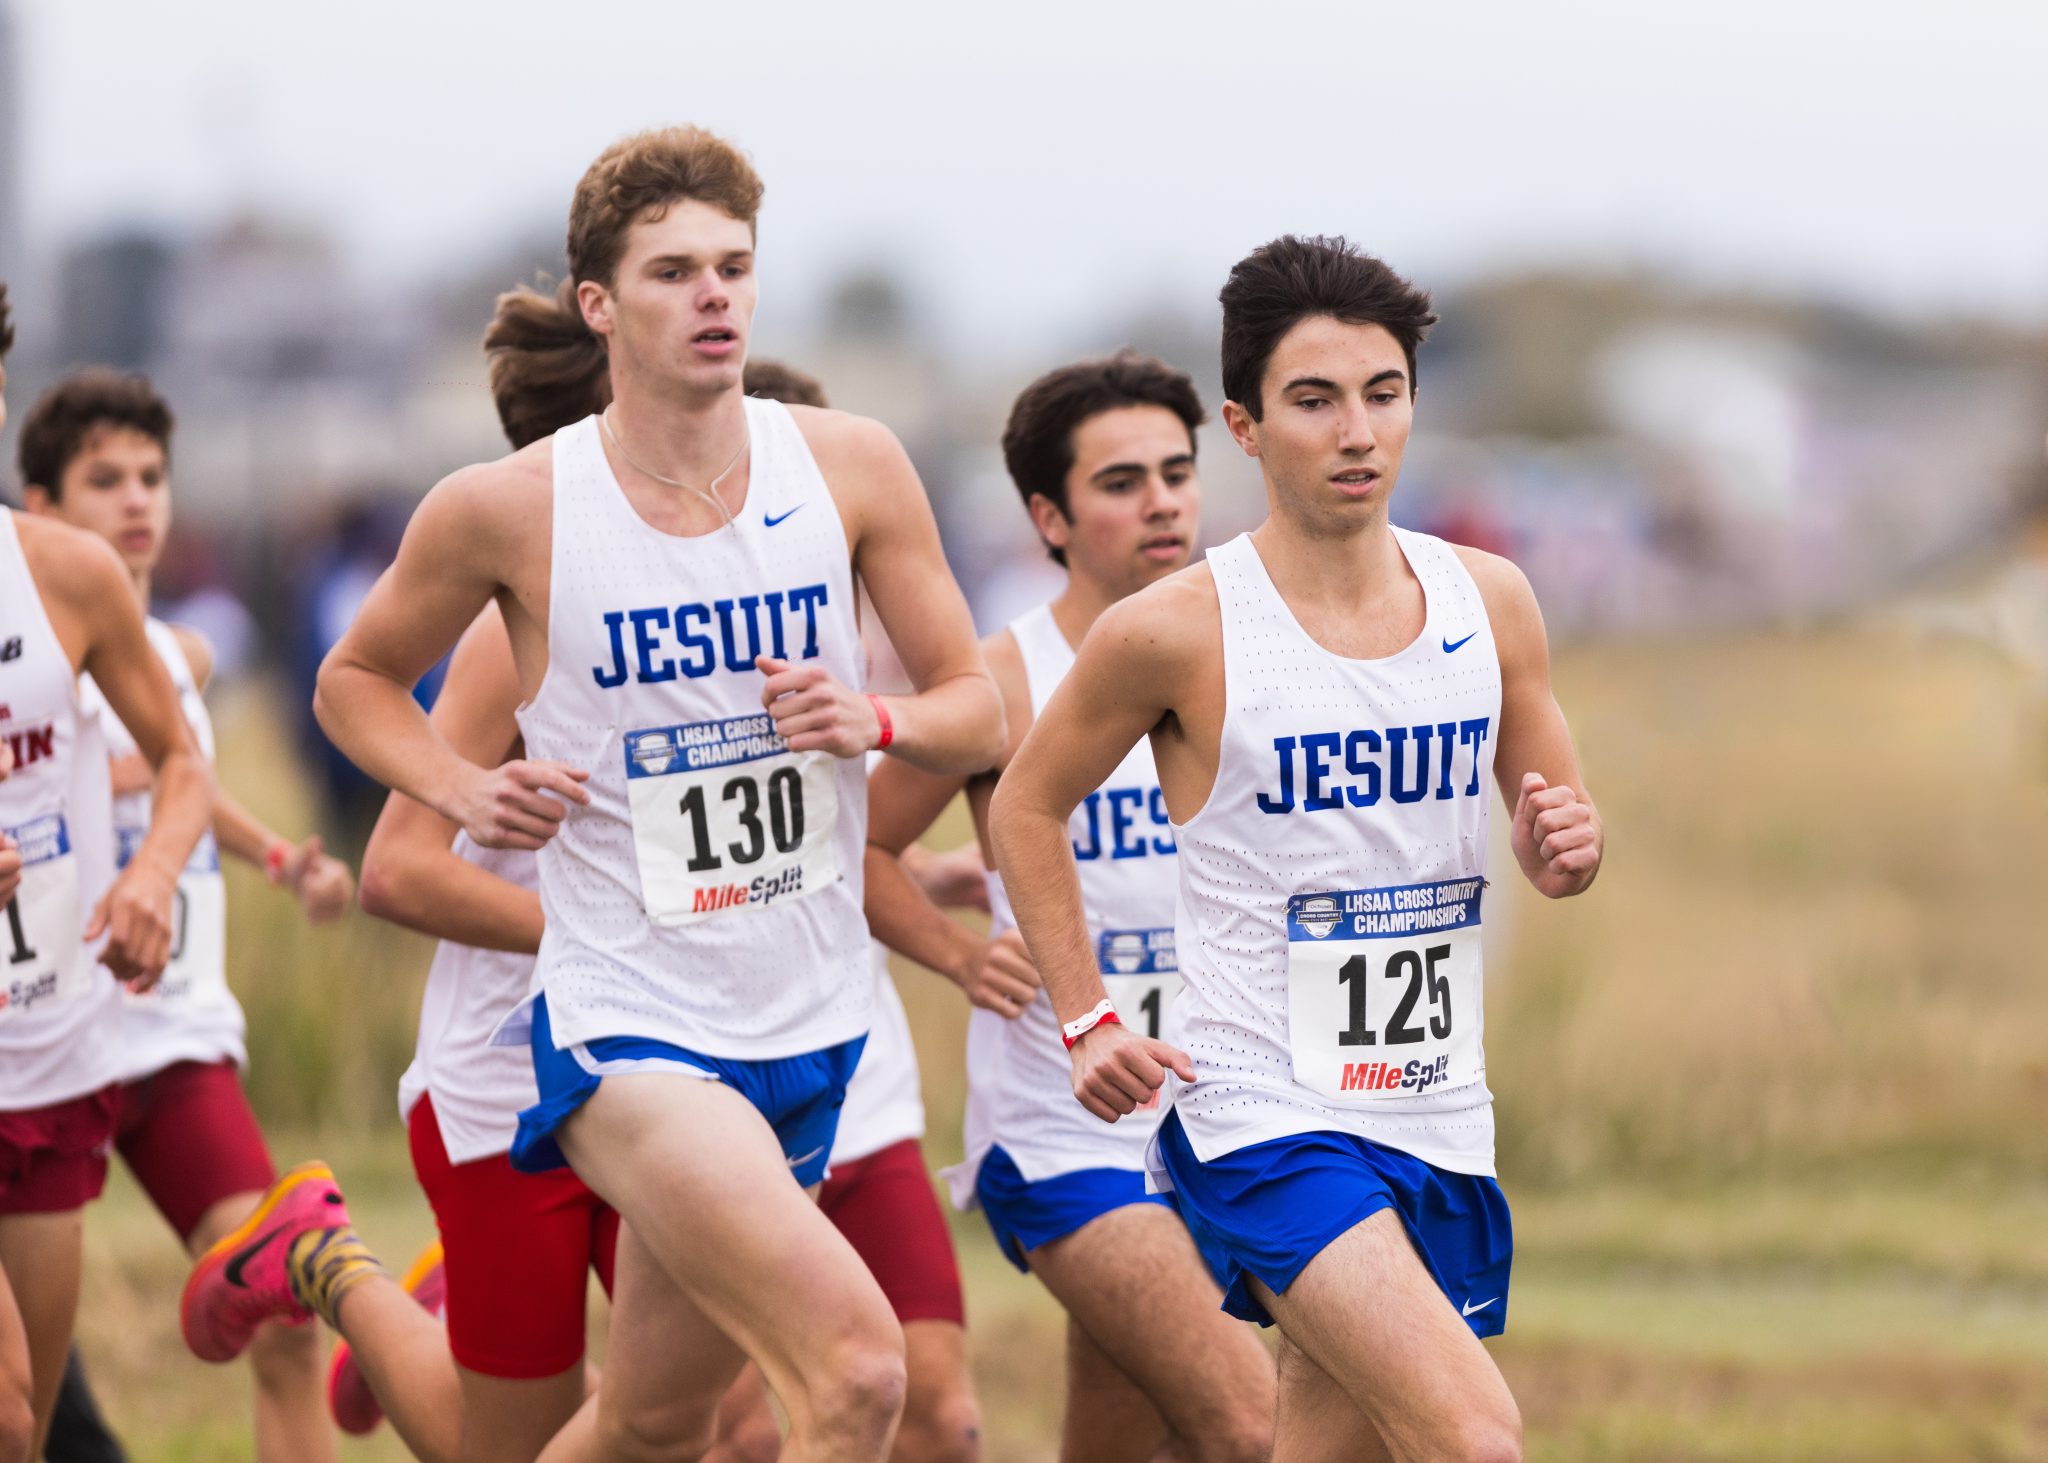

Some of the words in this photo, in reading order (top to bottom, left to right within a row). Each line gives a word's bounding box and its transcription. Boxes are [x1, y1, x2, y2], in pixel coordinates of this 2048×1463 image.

[592, 583, 828, 688] JESUIT
[676, 721, 723, 749] LHSAA
[724, 716, 769, 742] CROSS
[1256, 717, 1490, 814] JESUIT
[679, 766, 805, 872] 130
[692, 864, 803, 913] MileSplit
[1345, 892, 1392, 913] LHSAA
[1394, 887, 1434, 911] CROSS
[1436, 881, 1476, 905] COUNTRY
[1354, 903, 1467, 934] CHAMPIONSHIPS
[1339, 943, 1453, 1047] 125
[1340, 1053, 1450, 1094] MileSplit
